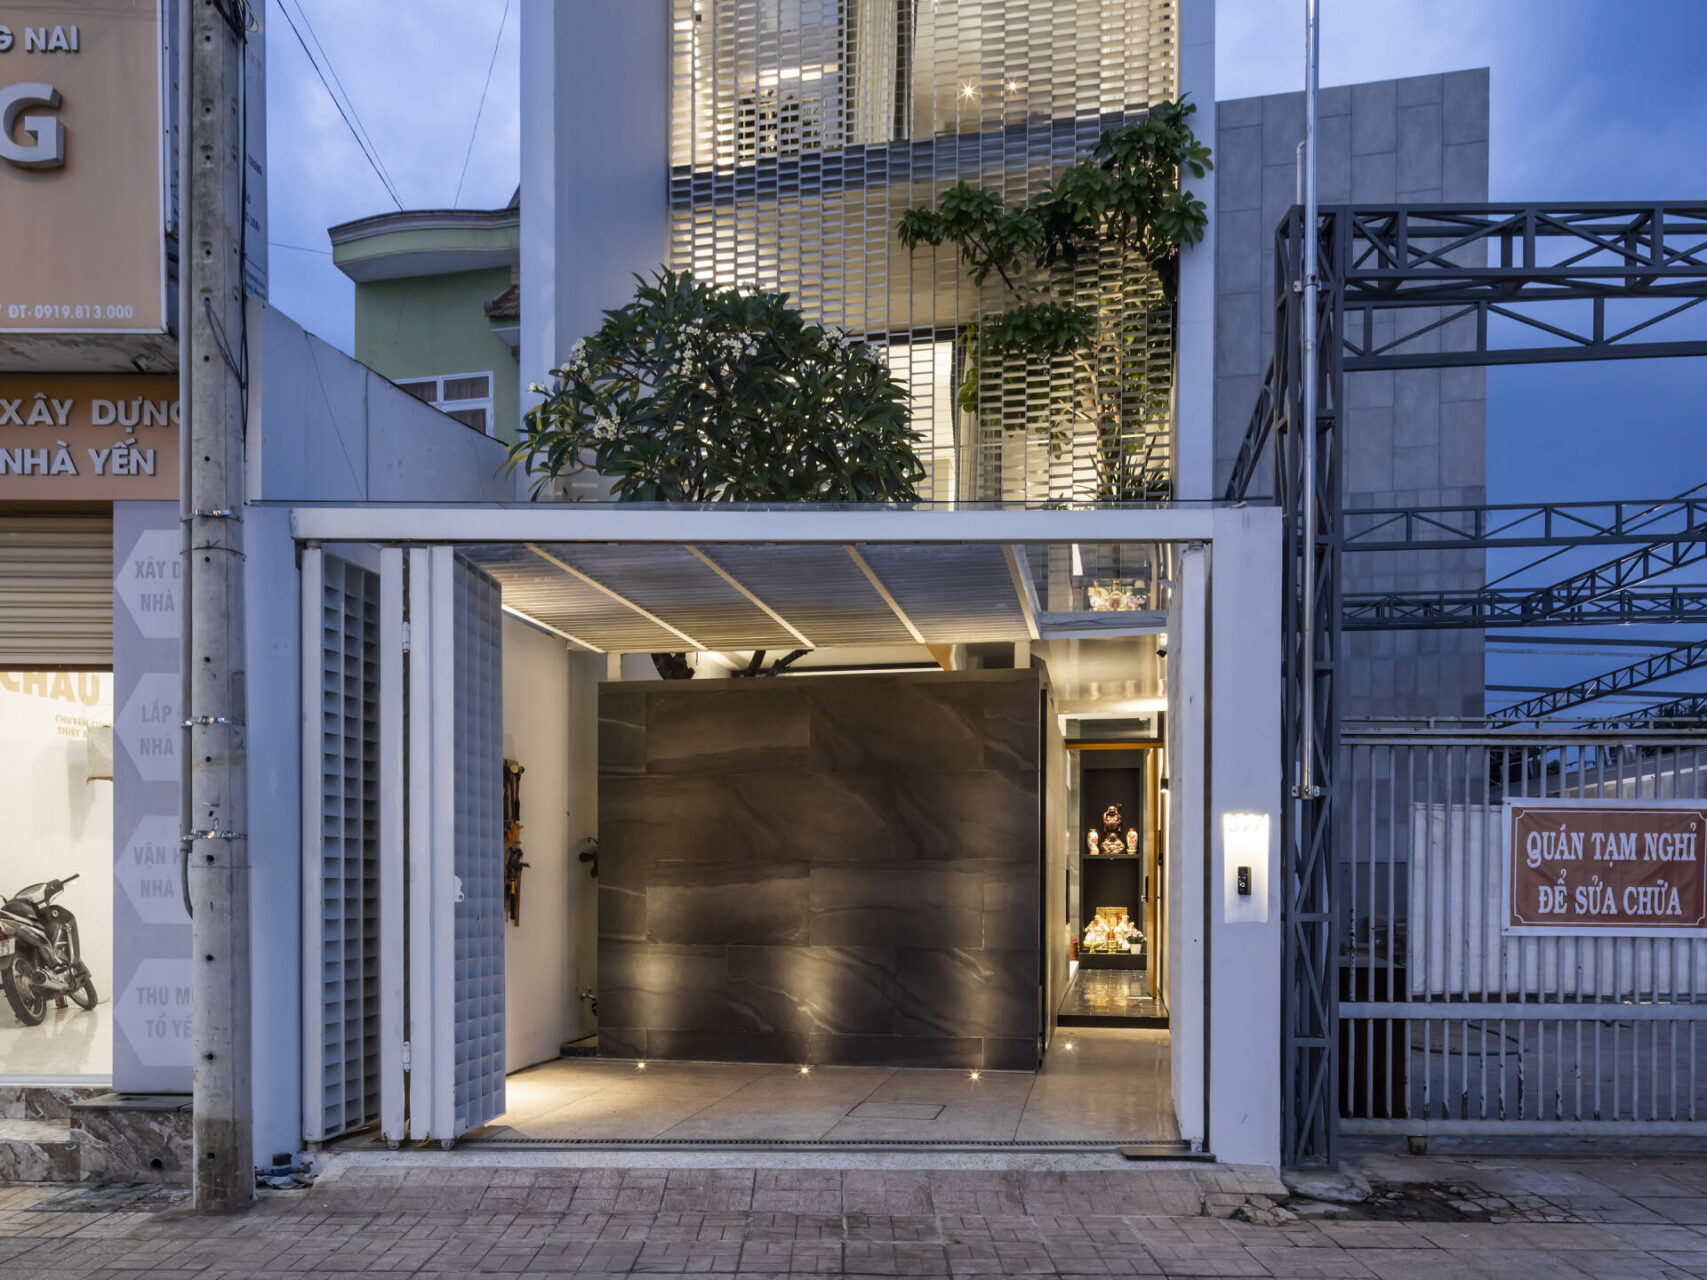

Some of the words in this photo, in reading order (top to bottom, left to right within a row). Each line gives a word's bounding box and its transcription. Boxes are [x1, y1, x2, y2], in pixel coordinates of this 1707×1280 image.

[24, 24, 79, 52] NAI
[0, 392, 74, 426] XÂY
[0, 439, 78, 475] NHÀ
[88, 437, 155, 475] YẾN
[135, 556, 166, 579] XÂY
[140, 588, 175, 612] NHÀ
[140, 732, 174, 756] NHÀ
[133, 842, 166, 869] VẬN
[1526, 823, 1585, 869] QUÁN
[1591, 832, 1638, 868] TẠM
[1643, 821, 1697, 862] NGHỈ
[140, 874, 174, 898] NHÀ
[1538, 868, 1568, 914] ĐỂ
[1575, 874, 1618, 915] SỬA
[1623, 879, 1683, 915] CHỮA
[136, 986, 169, 1006] THU
